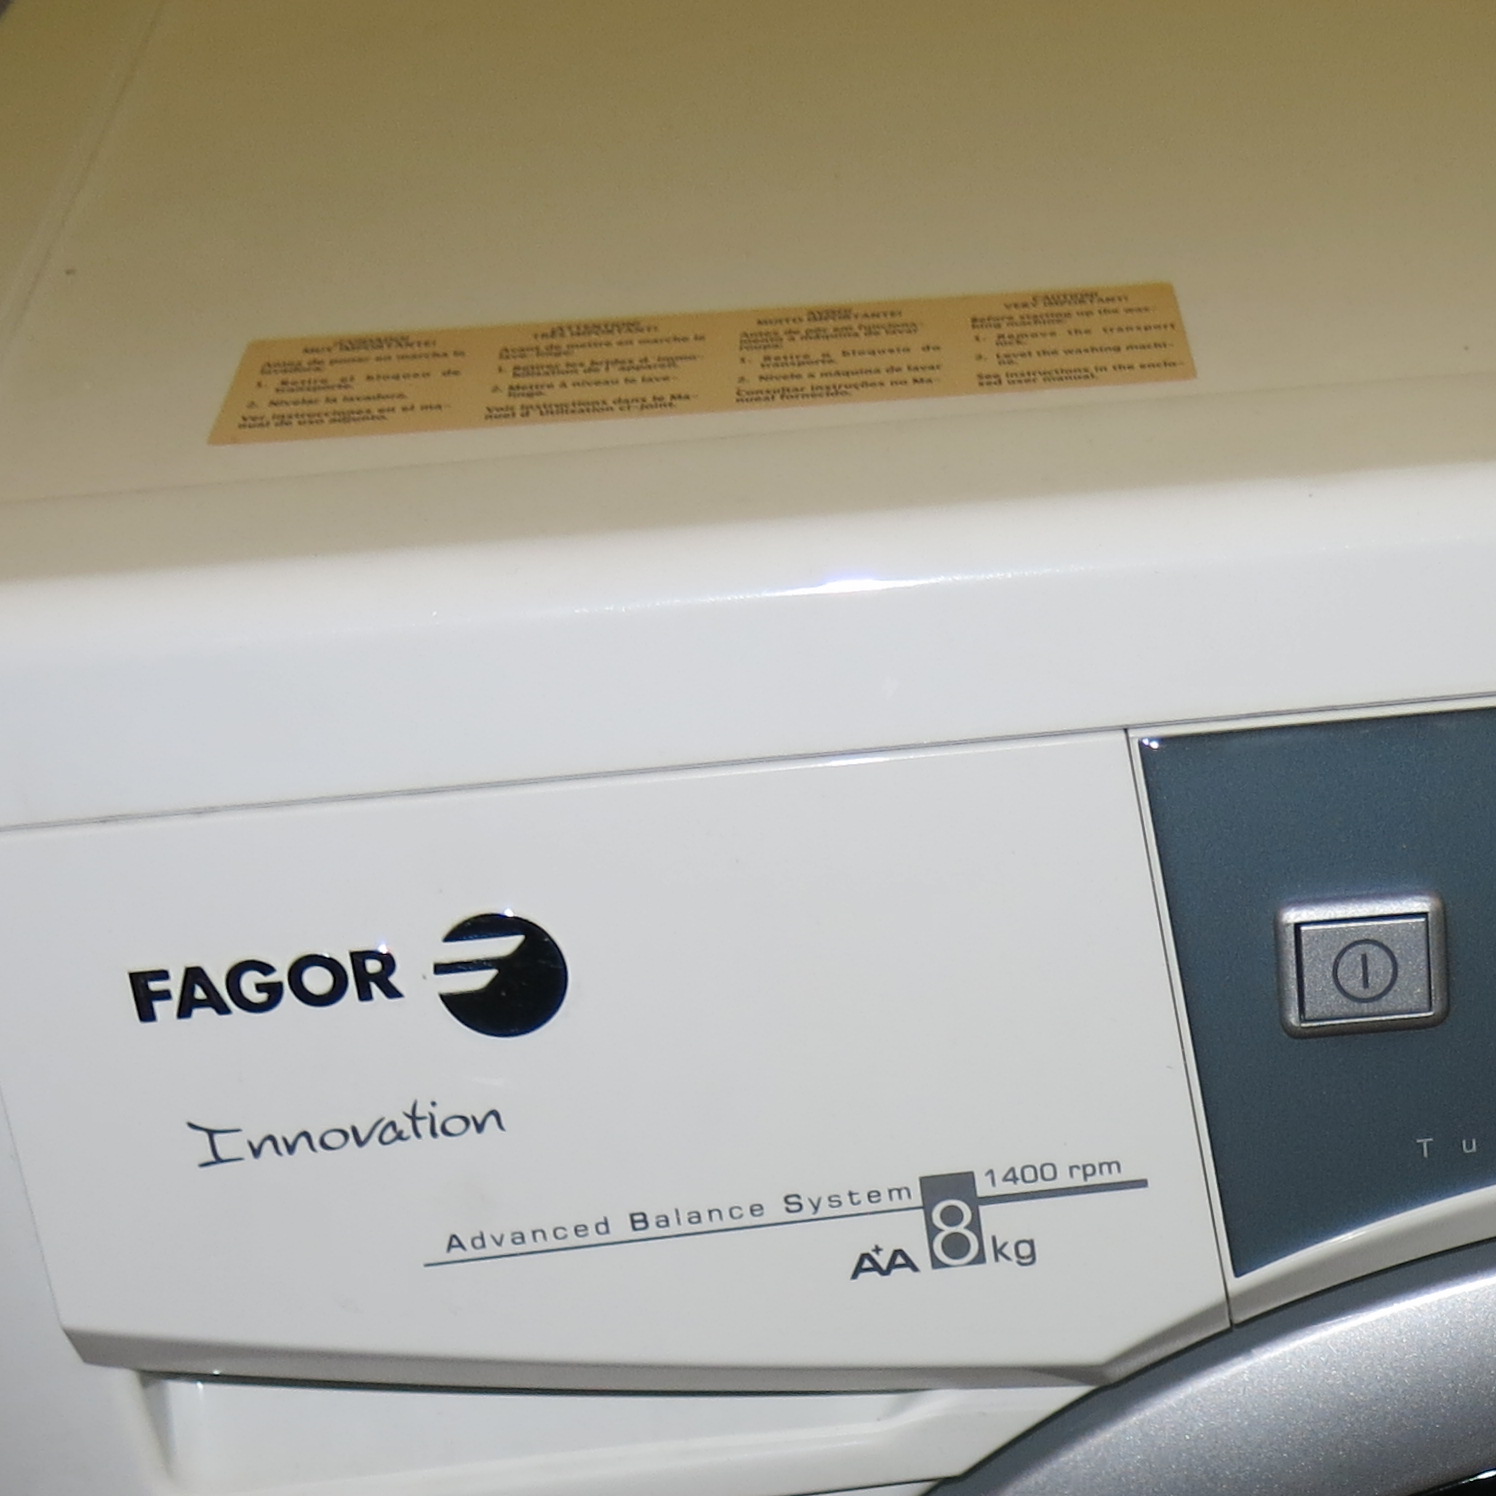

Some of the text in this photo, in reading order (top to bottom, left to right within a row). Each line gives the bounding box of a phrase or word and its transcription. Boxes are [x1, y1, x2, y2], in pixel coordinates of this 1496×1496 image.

[128, 947, 404, 1023] FAGOR
[187, 1099, 506, 1168] Innovation
[984, 1157, 1122, 1189] 1400 rpm
[446, 1183, 913, 1254] Advanced Balance System
